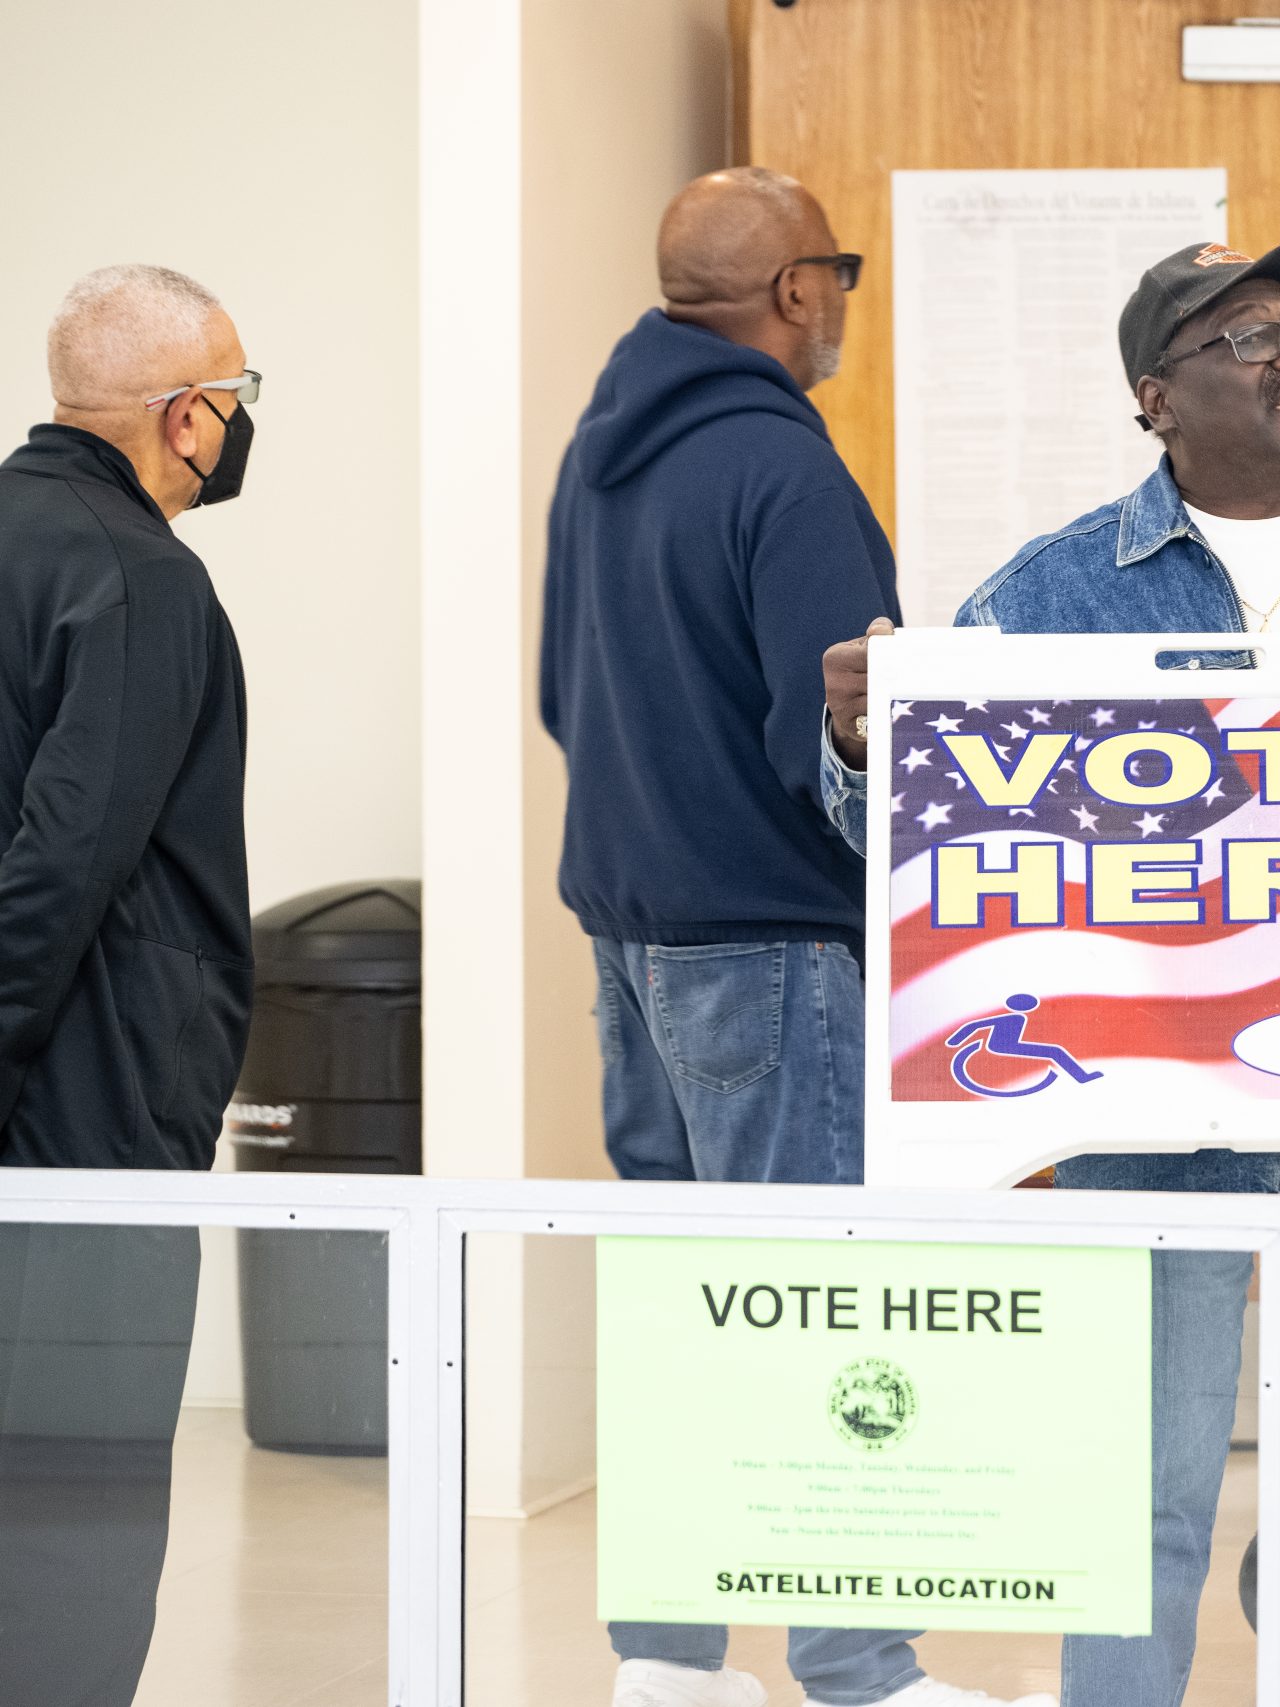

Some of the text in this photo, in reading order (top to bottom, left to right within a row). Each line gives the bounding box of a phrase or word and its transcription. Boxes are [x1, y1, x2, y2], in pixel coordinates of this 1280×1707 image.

[701, 1284, 1042, 1333] VOTE HERE
[717, 1572, 1055, 1600] SATELLITE LOCATION
